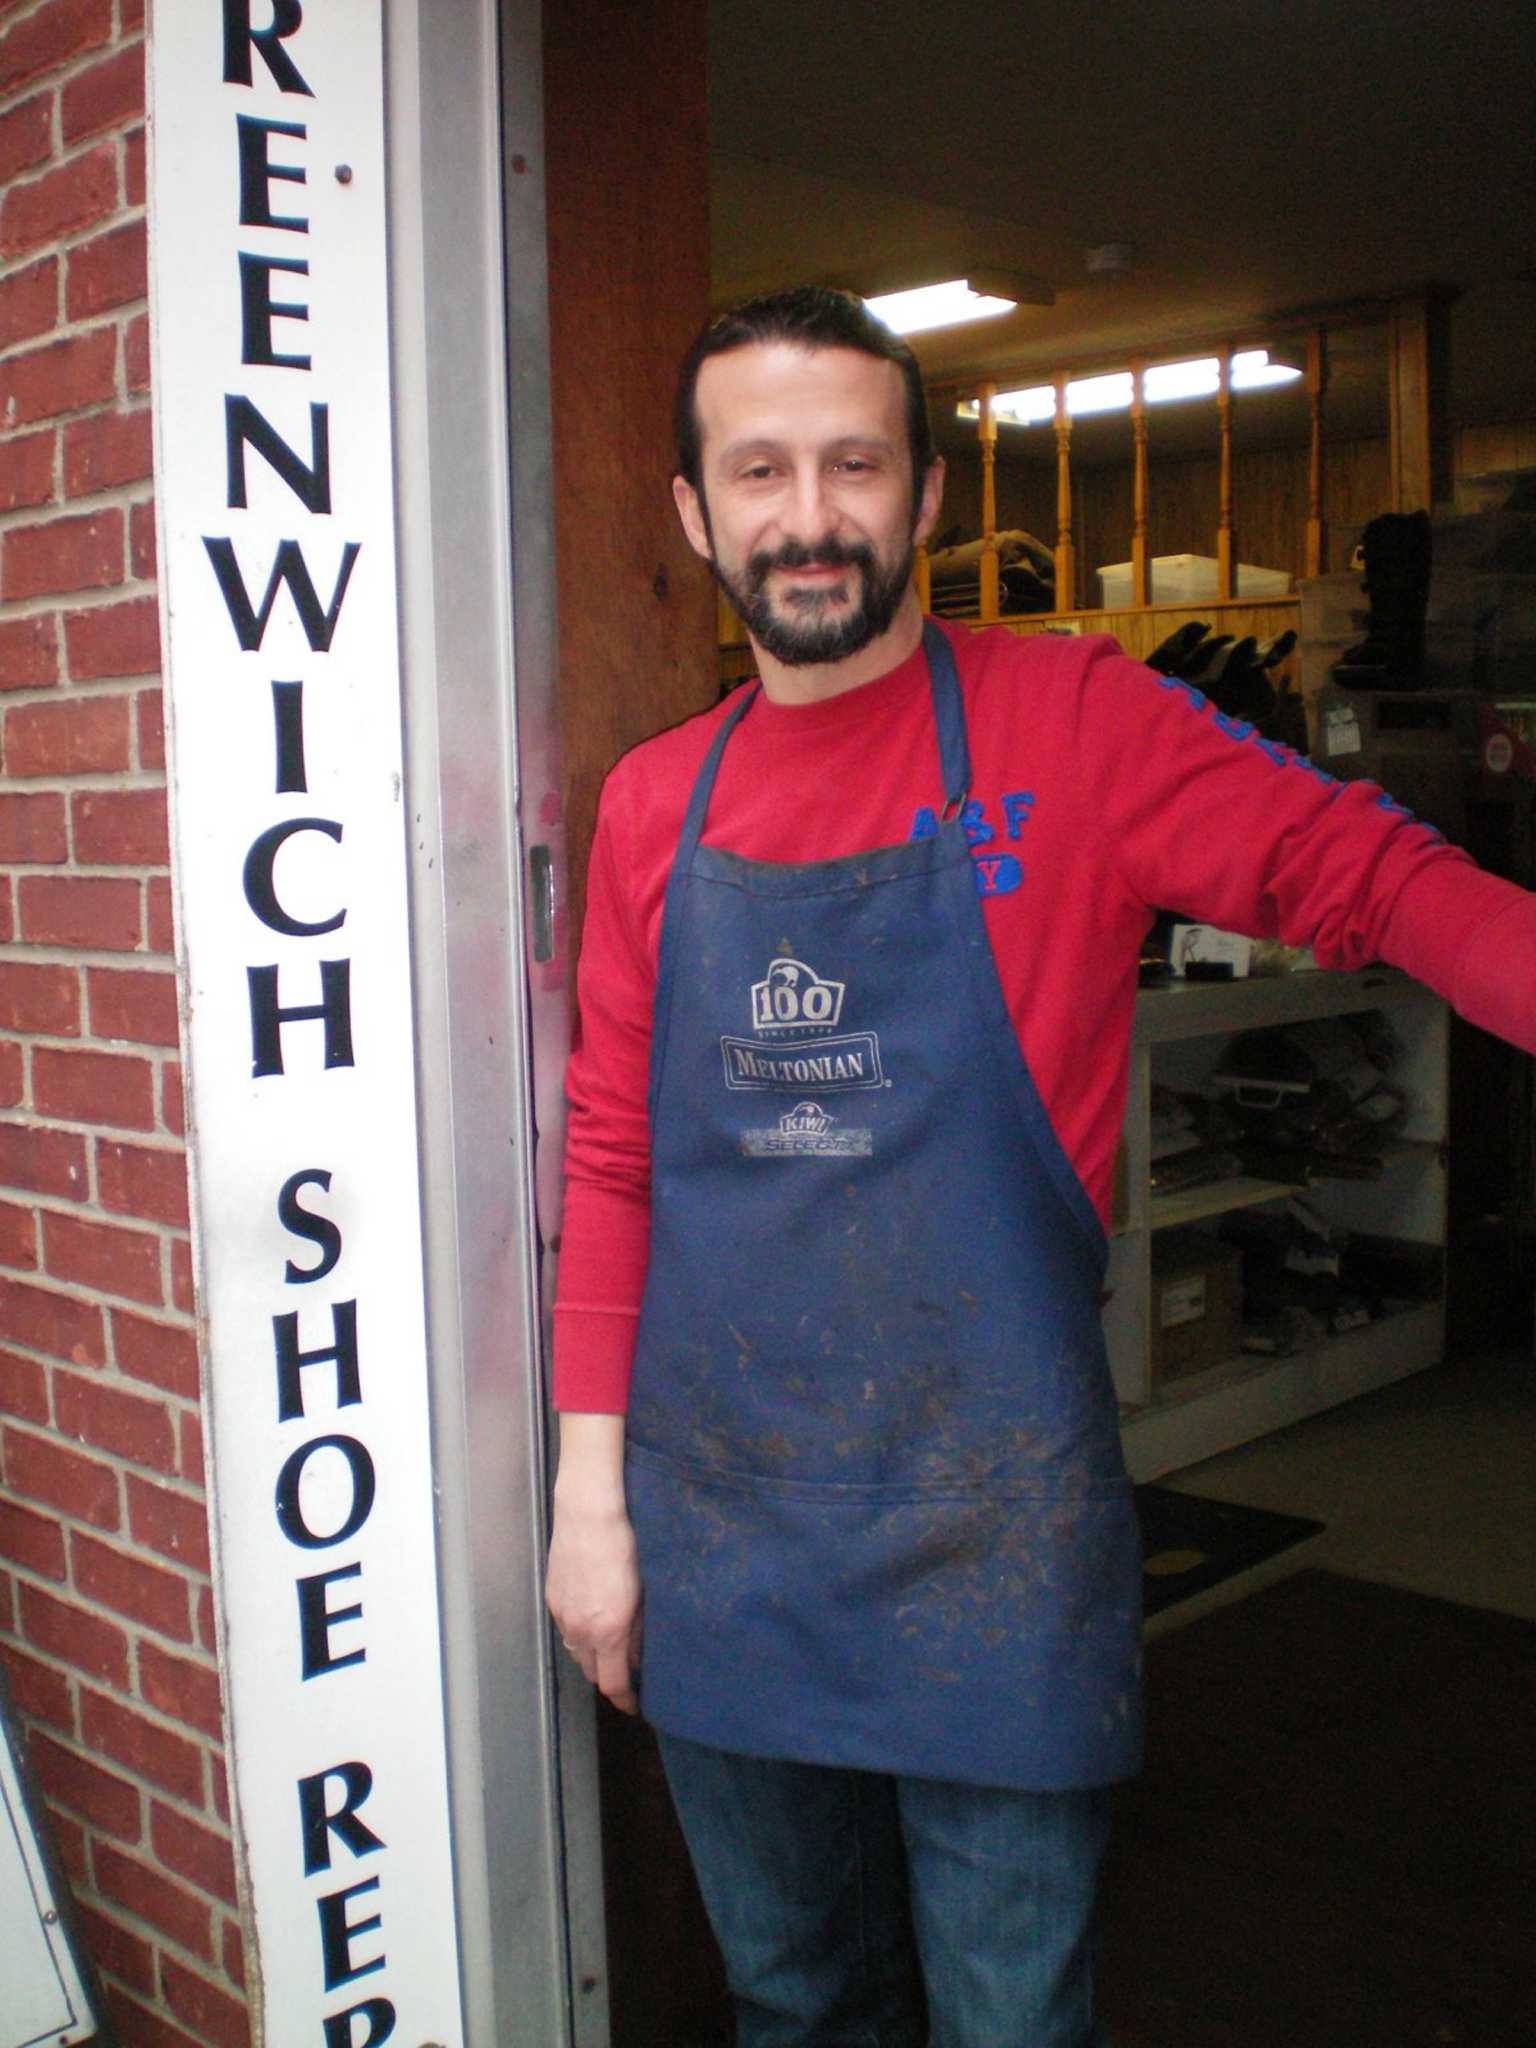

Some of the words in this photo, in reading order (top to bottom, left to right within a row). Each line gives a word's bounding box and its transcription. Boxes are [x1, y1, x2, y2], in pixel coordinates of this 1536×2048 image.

[760, 985, 833, 1022] 100
[733, 1048, 864, 1082] MELTONIAN
[785, 1117, 827, 1131] KIWI
[272, 1168, 376, 1681] SHOE
